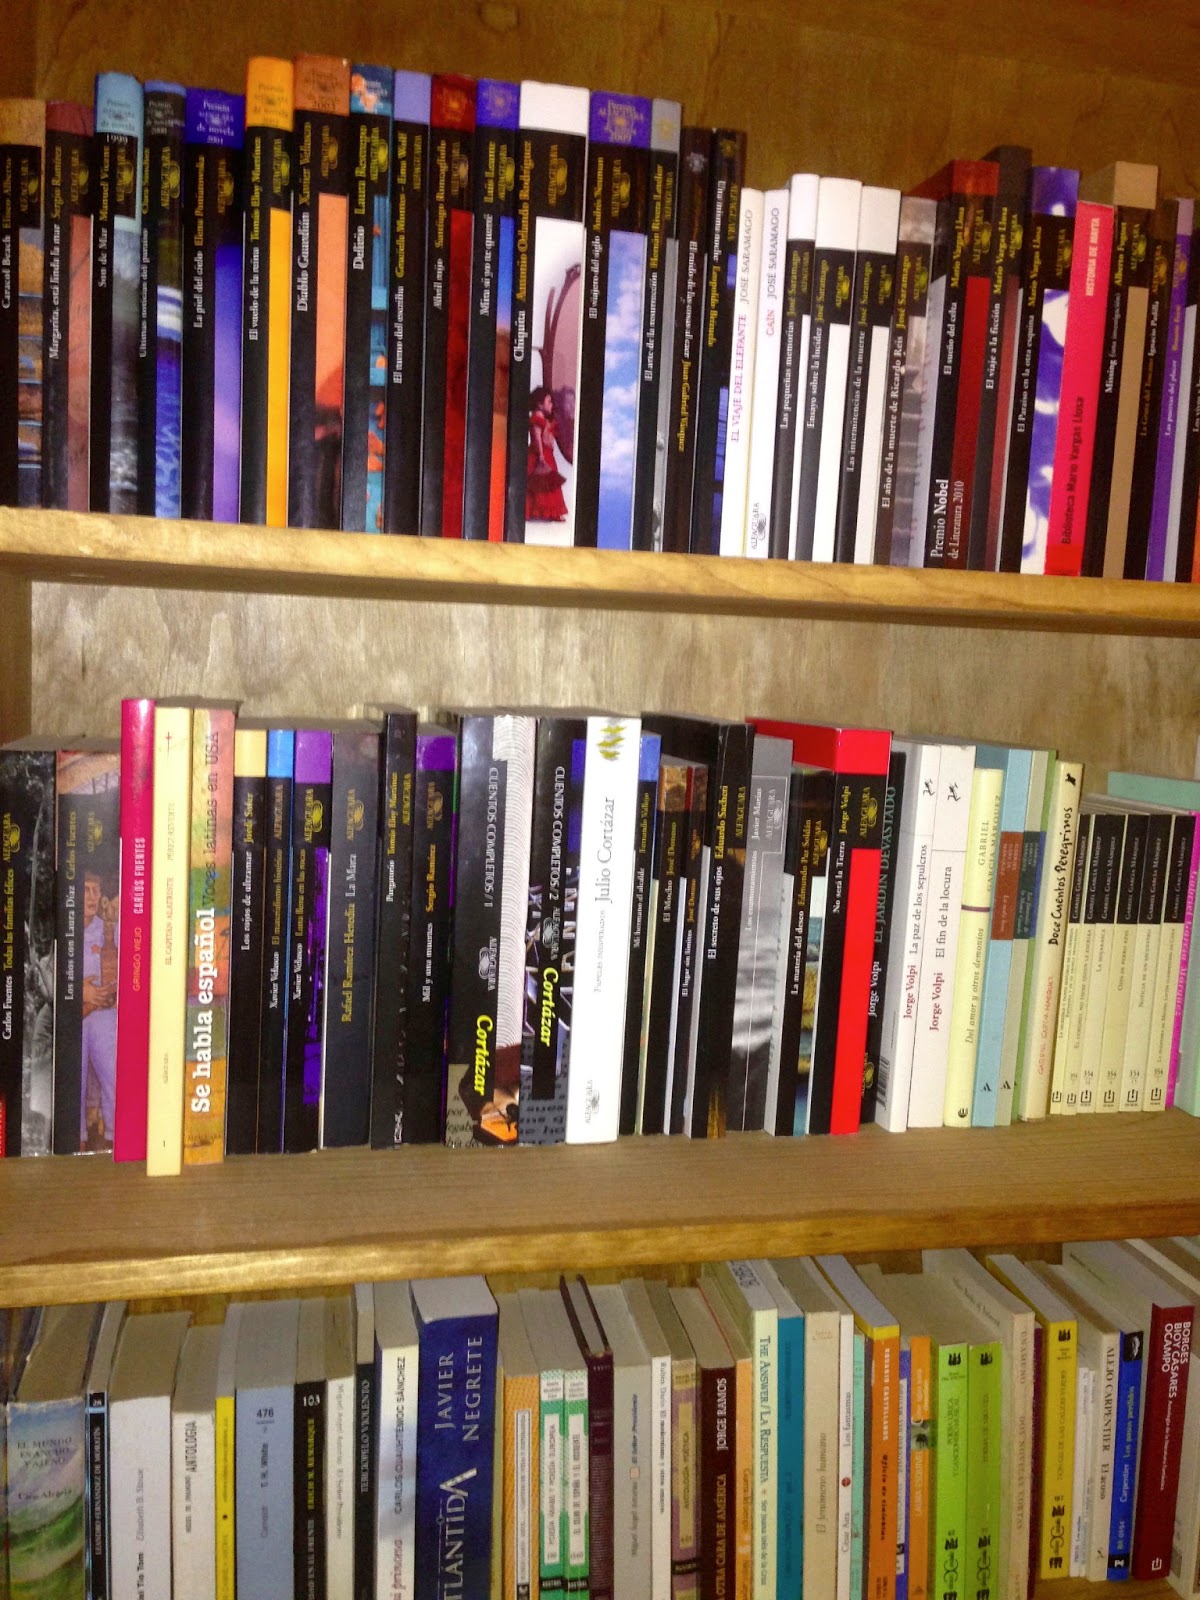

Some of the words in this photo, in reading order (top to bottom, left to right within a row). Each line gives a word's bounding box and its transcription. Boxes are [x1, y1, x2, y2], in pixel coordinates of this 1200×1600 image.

[106, 134, 128, 145] 1999
[954, 207, 965, 230] Llosa
[1090, 218, 1100, 244] MAYTA
[2, 235, 12, 266] Beach
[298, 212, 310, 268] Guardián
[353, 226, 364, 270] Delirio
[740, 210, 753, 272] SARAMAGO
[768, 208, 780, 270] SARAMAGO
[952, 231, 965, 259] Vargas
[1089, 246, 1098, 257] DE
[766, 273, 777, 299] JOSÉ
[788, 250, 801, 295] Saramago
[898, 256, 911, 305] Saramago
[950, 261, 961, 288] Mario
[1086, 258, 1097, 297] HISTORIA
[2, 269, 12, 309] Caracol
[297, 271, 309, 312] Diablo
[738, 276, 750, 304] JOSÉ
[787, 296, 797, 316] José
[896, 309, 907, 329] José
[946, 302, 958, 322] celta
[514, 311, 529, 362] Chiquita
[765, 310, 776, 335] CAÍN
[945, 323, 956, 338] del
[735, 315, 747, 370] ELEFANTE
[784, 321, 794, 366] memorias
[893, 336, 903, 357] Reis
[944, 339, 955, 364] sueño
[734, 373, 744, 395] DEL
[890, 361, 902, 398] Ricardo
[943, 366, 952, 375] El
[1105, 360, 1117, 394] Missing
[781, 368, 792, 411] pequeñas
[732, 398, 742, 427] VIAJE
[889, 401, 899, 412] de
[780, 413, 789, 429] Las
[886, 413, 898, 450] muerte
[730, 429, 739, 442] EL
[885, 463, 895, 474] de
[886, 452, 896, 462] la
[883, 476, 893, 495] año
[933, 479, 949, 515] Nobel
[952, 480, 965, 503] 2010
[881, 498, 891, 509] El
[751, 502, 760, 549] ALFAGUARA
[930, 518, 946, 558] Premio
[949, 505, 963, 547] Literatura
[948, 549, 959, 560] de
[205, 731, 219, 766] USA
[207, 772, 219, 792] en
[487, 768, 499, 823] CUENTOS
[553, 766, 565, 820] CUENTOS
[717, 785, 729, 819] Sacheri
[753, 788, 763, 815] Marías
[840, 785, 851, 809] Volpi
[736, 786, 747, 837] ALFAGUARA
[839, 811, 850, 834] Jorge
[860, 787, 871, 837] ALFAGUARA
[2, 813, 12, 863] ALFAGUARA
[67, 811, 77, 848] Fuentes
[203, 799, 218, 855] latinas
[596, 797, 615, 863] Cortázar
[715, 820, 726, 859] Eduardo
[751, 817, 761, 840] Javier
[1055, 806, 1075, 873] Peregrinos
[135, 837, 146, 877] FUENTES
[836, 841, 847, 868] Tierra
[978, 820, 990, 866] GABRIEL
[66, 850, 77, 880] Carlos
[485, 824, 497, 893] COMPLETOS
[915, 845, 929, 890] sepulcros
[201, 862, 216, 907] Voces
[594, 868, 613, 904] Julio
[713, 866, 725, 886] ojos
[835, 870, 844, 879] la
[940, 866, 953, 900] locura
[65, 885, 76, 908] Díaz
[133, 879, 144, 915] CARLOS
[713, 887, 721, 901] sus
[834, 880, 843, 898] será
[913, 892, 923, 906] los
[1050, 876, 1068, 919] Cuentos
[711, 902, 720, 914] de
[832, 899, 841, 914] No
[912, 908, 921, 920] de
[939, 902, 950, 912] la
[1071, 893, 1080, 920] GABRIEL
[65, 910, 76, 937] Laura
[710, 915, 720, 947] secreto
[912, 922, 922, 939] paz
[938, 914, 949, 928] de
[1048, 921, 1062, 946] Doce
[67, 940, 75, 957] con
[133, 927, 143, 951] VIEJO
[909, 943, 919, 955] La
[937, 929, 947, 945] fin
[973, 927, 986, 968] demonios
[194, 907, 218, 1005] español
[487, 936, 497, 991] ALFAGUARA
[708, 948, 717, 959] El
[935, 948, 945, 958] El
[66, 959, 75, 982] años
[132, 953, 142, 991] GRINGO
[905, 964, 917, 991] Volpi
[971, 971, 981, 993] otros
[3, 976, 13, 1010] Fuentes
[65, 984, 74, 1001] Los
[931, 972, 944, 1001] Volpi
[540, 967, 559, 1047] Cortázar
[902, 992, 914, 1019] Jorge
[929, 1001, 941, 1032] Jorge
[968, 1003, 977, 1027] amor
[2, 1011, 13, 1040] Carlos
[964, 1029, 975, 1044] Del
[192, 1010, 213, 1079] habla
[474, 1014, 494, 1096] Cortázar
[191, 1084, 211, 1113] Se
[759, 1335, 771, 1357] THE
[1161, 1323, 1173, 1373] OCAMPO
[1171, 1322, 1182, 1347] BIOY
[1180, 1321, 1191, 1364] BORGES
[1105, 1346, 1115, 1381] ALEJO
[1168, 1350, 1180, 1398] CASARES
[394, 1356, 406, 1403] SÁNCHEZ
[435, 1353, 456, 1430] JAVIER
[462, 1336, 483, 1441] NEGRETE
[302, 1395, 321, 1408] 103
[717, 1378, 728, 1416] RAMOS
[843, 1391, 852, 1431] fantasmas
[1126, 1386, 1136, 1419] perdidos
[256, 1408, 275, 1419] 476
[1102, 1384, 1114, 1451] CARPENTIER
[717, 1418, 729, 1450] JORGE
[843, 1433, 851, 1447] Los
[1125, 1421, 1134, 1442] pasos
[759, 1429, 771, 1485] RESPUESTA
[1123, 1444, 1131, 1458] Los
[1101, 1463, 1110, 1473] El
[394, 1475, 404, 1514] CARLOS
[713, 1474, 727, 1520] AMÉRICA
[1119, 1464, 1130, 1502] Carpentier
[716, 1522, 727, 1537] DE
[841, 1512, 850, 1529] Aira
[716, 1540, 727, 1565] CARA
[841, 1531, 850, 1553] César
[716, 1567, 727, 1595] OTRA
